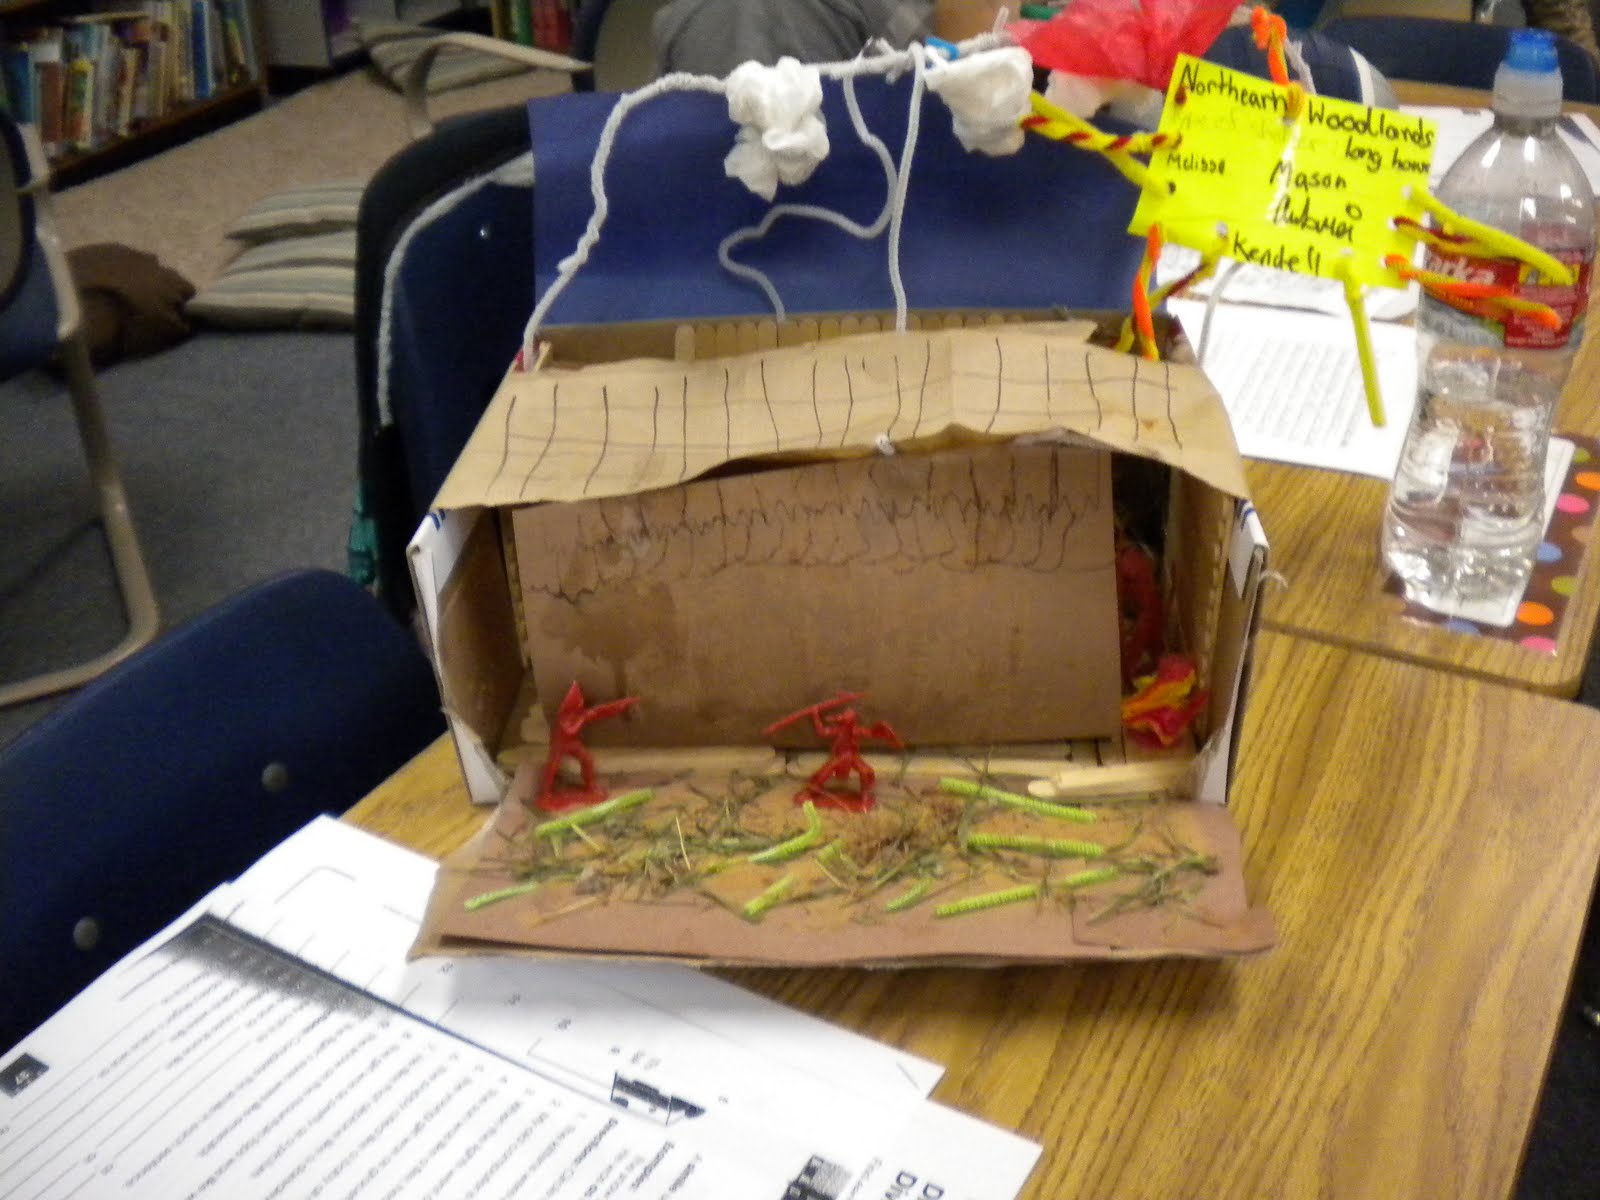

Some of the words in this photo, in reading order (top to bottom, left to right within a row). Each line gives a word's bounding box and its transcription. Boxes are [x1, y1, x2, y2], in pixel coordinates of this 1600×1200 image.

[1308, 102, 1435, 149] Woodlands
[1166, 152, 1226, 175] Melissa
[1344, 135, 1382, 173] long
[1269, 160, 1347, 192] Mason
[1233, 231, 1321, 277] Kendell
